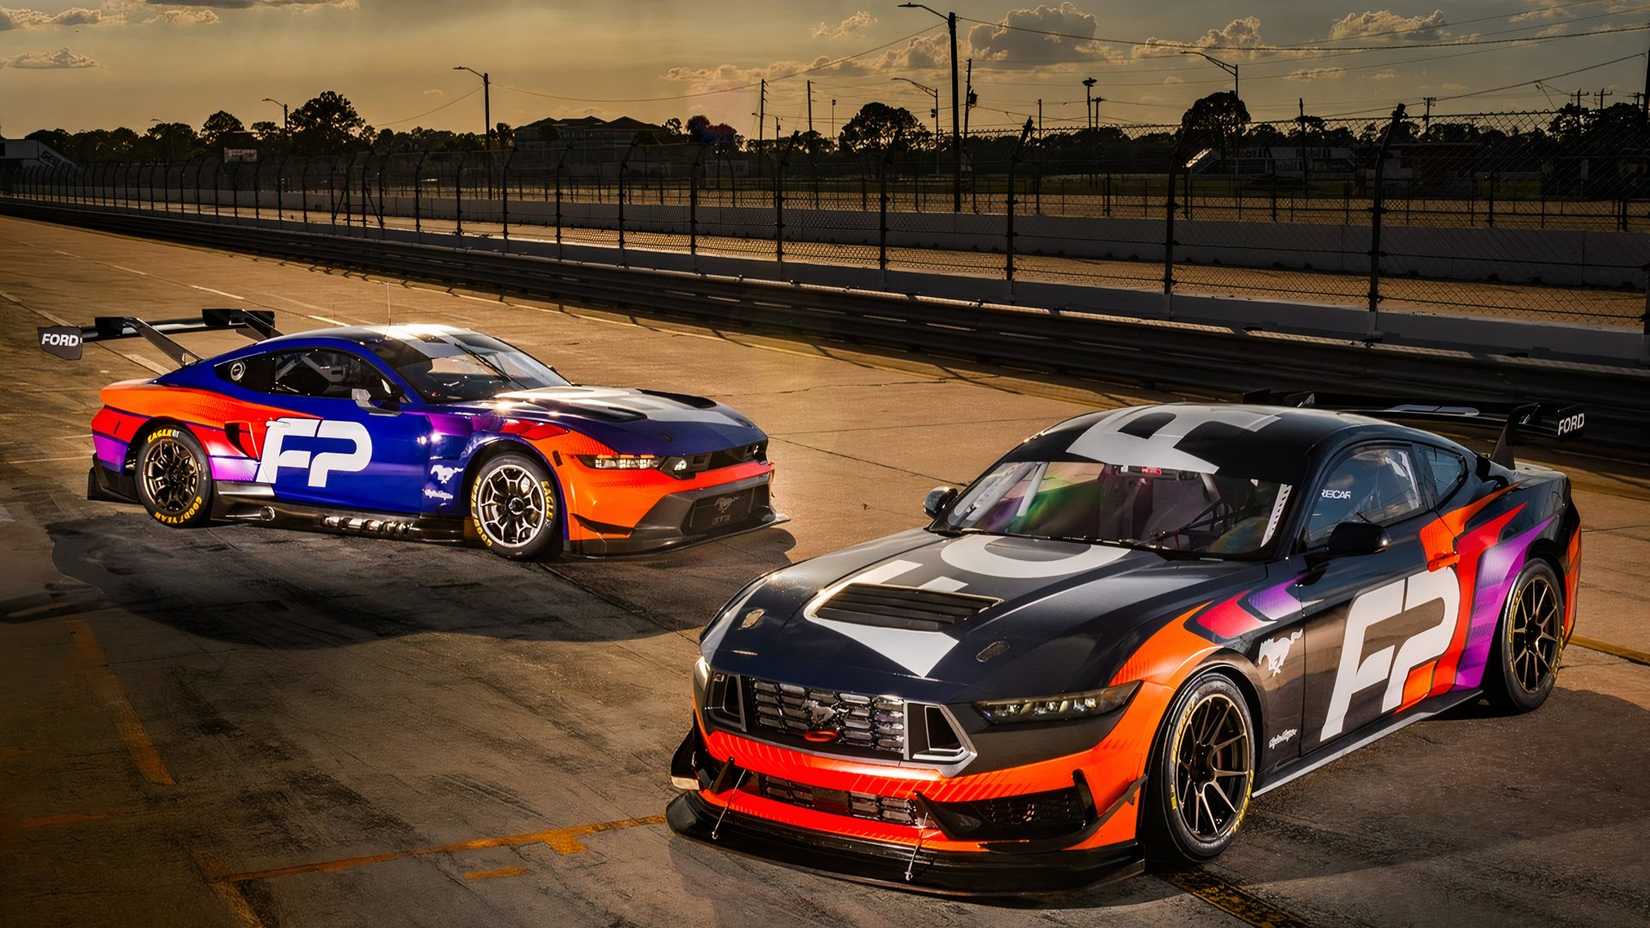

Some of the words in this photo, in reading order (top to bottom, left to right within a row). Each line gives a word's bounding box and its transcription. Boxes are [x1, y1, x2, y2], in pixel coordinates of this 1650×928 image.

[41, 333, 79, 347] FORD
[1557, 412, 1585, 436] FORD
[255, 416, 373, 488] FP
[154, 495, 202, 524] GOODYEAR
[471, 474, 493, 547] GOODYEAR
[541, 480, 554, 521] EAGLE
[1319, 566, 1461, 743] FP
